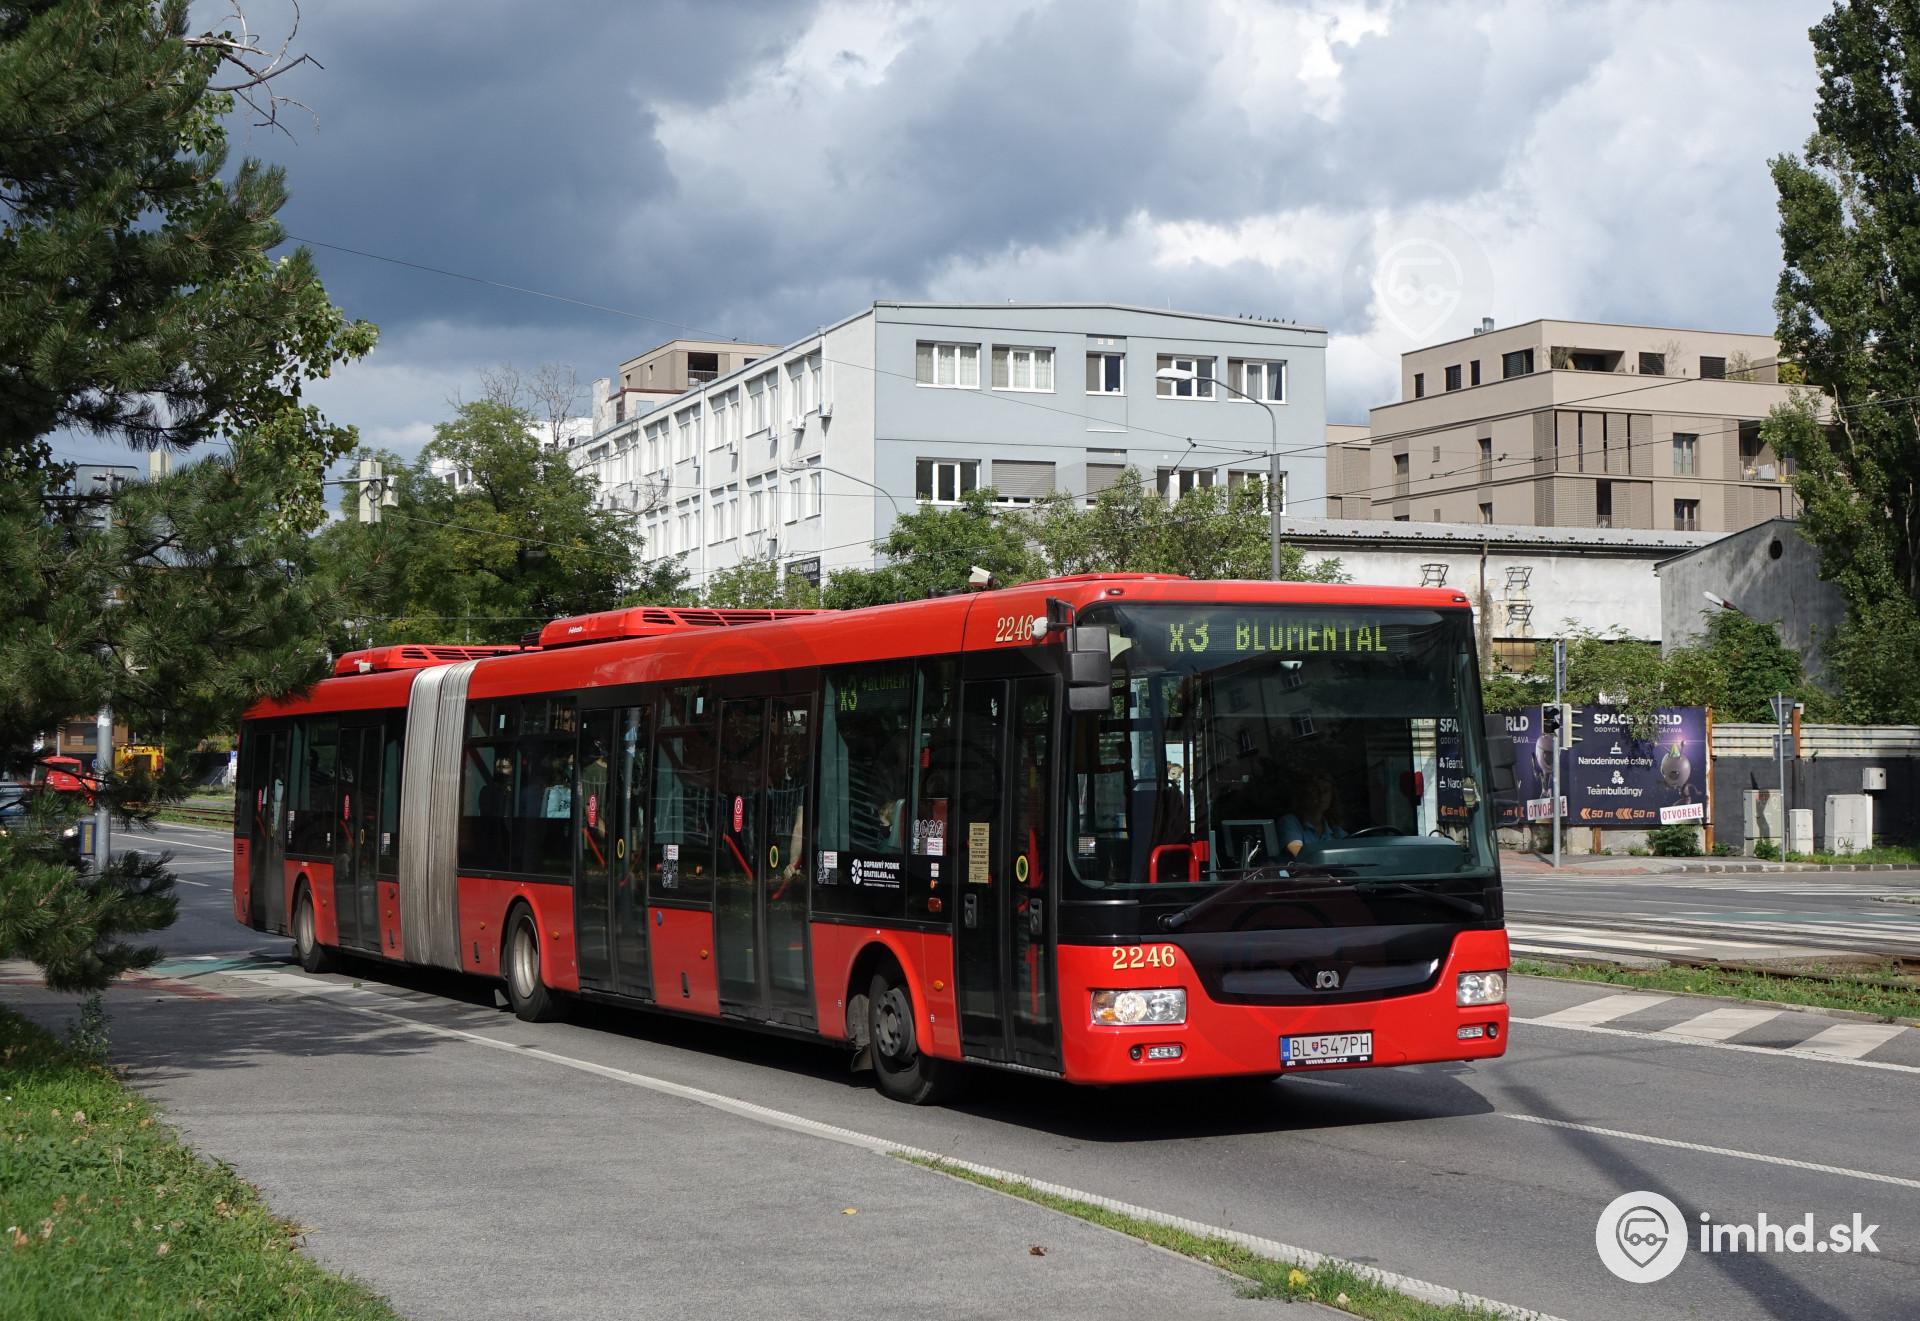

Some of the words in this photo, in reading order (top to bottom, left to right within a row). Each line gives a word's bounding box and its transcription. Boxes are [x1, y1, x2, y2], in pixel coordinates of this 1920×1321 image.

[995, 614, 1034, 643] 2246
[1169, 621, 1210, 652] X3
[1236, 618, 1388, 651] BLUMENTAL
[1440, 718, 1459, 733] SPA
[1505, 716, 1530, 732] RLD
[1593, 713, 1634, 725] SPACE
[1512, 736, 1529, 744] BAVA
[1578, 756, 1630, 766] Narodeninové
[1630, 756, 1654, 767] oslavy
[1587, 786, 1643, 797] Teambuildingy
[1591, 809, 1604, 818] 50
[1633, 809, 1645, 818] 50
[1112, 945, 1176, 970] 2246
[1320, 1036, 1369, 1055] 547PH
[1305, 1057, 1348, 1066] www.sor.cz
